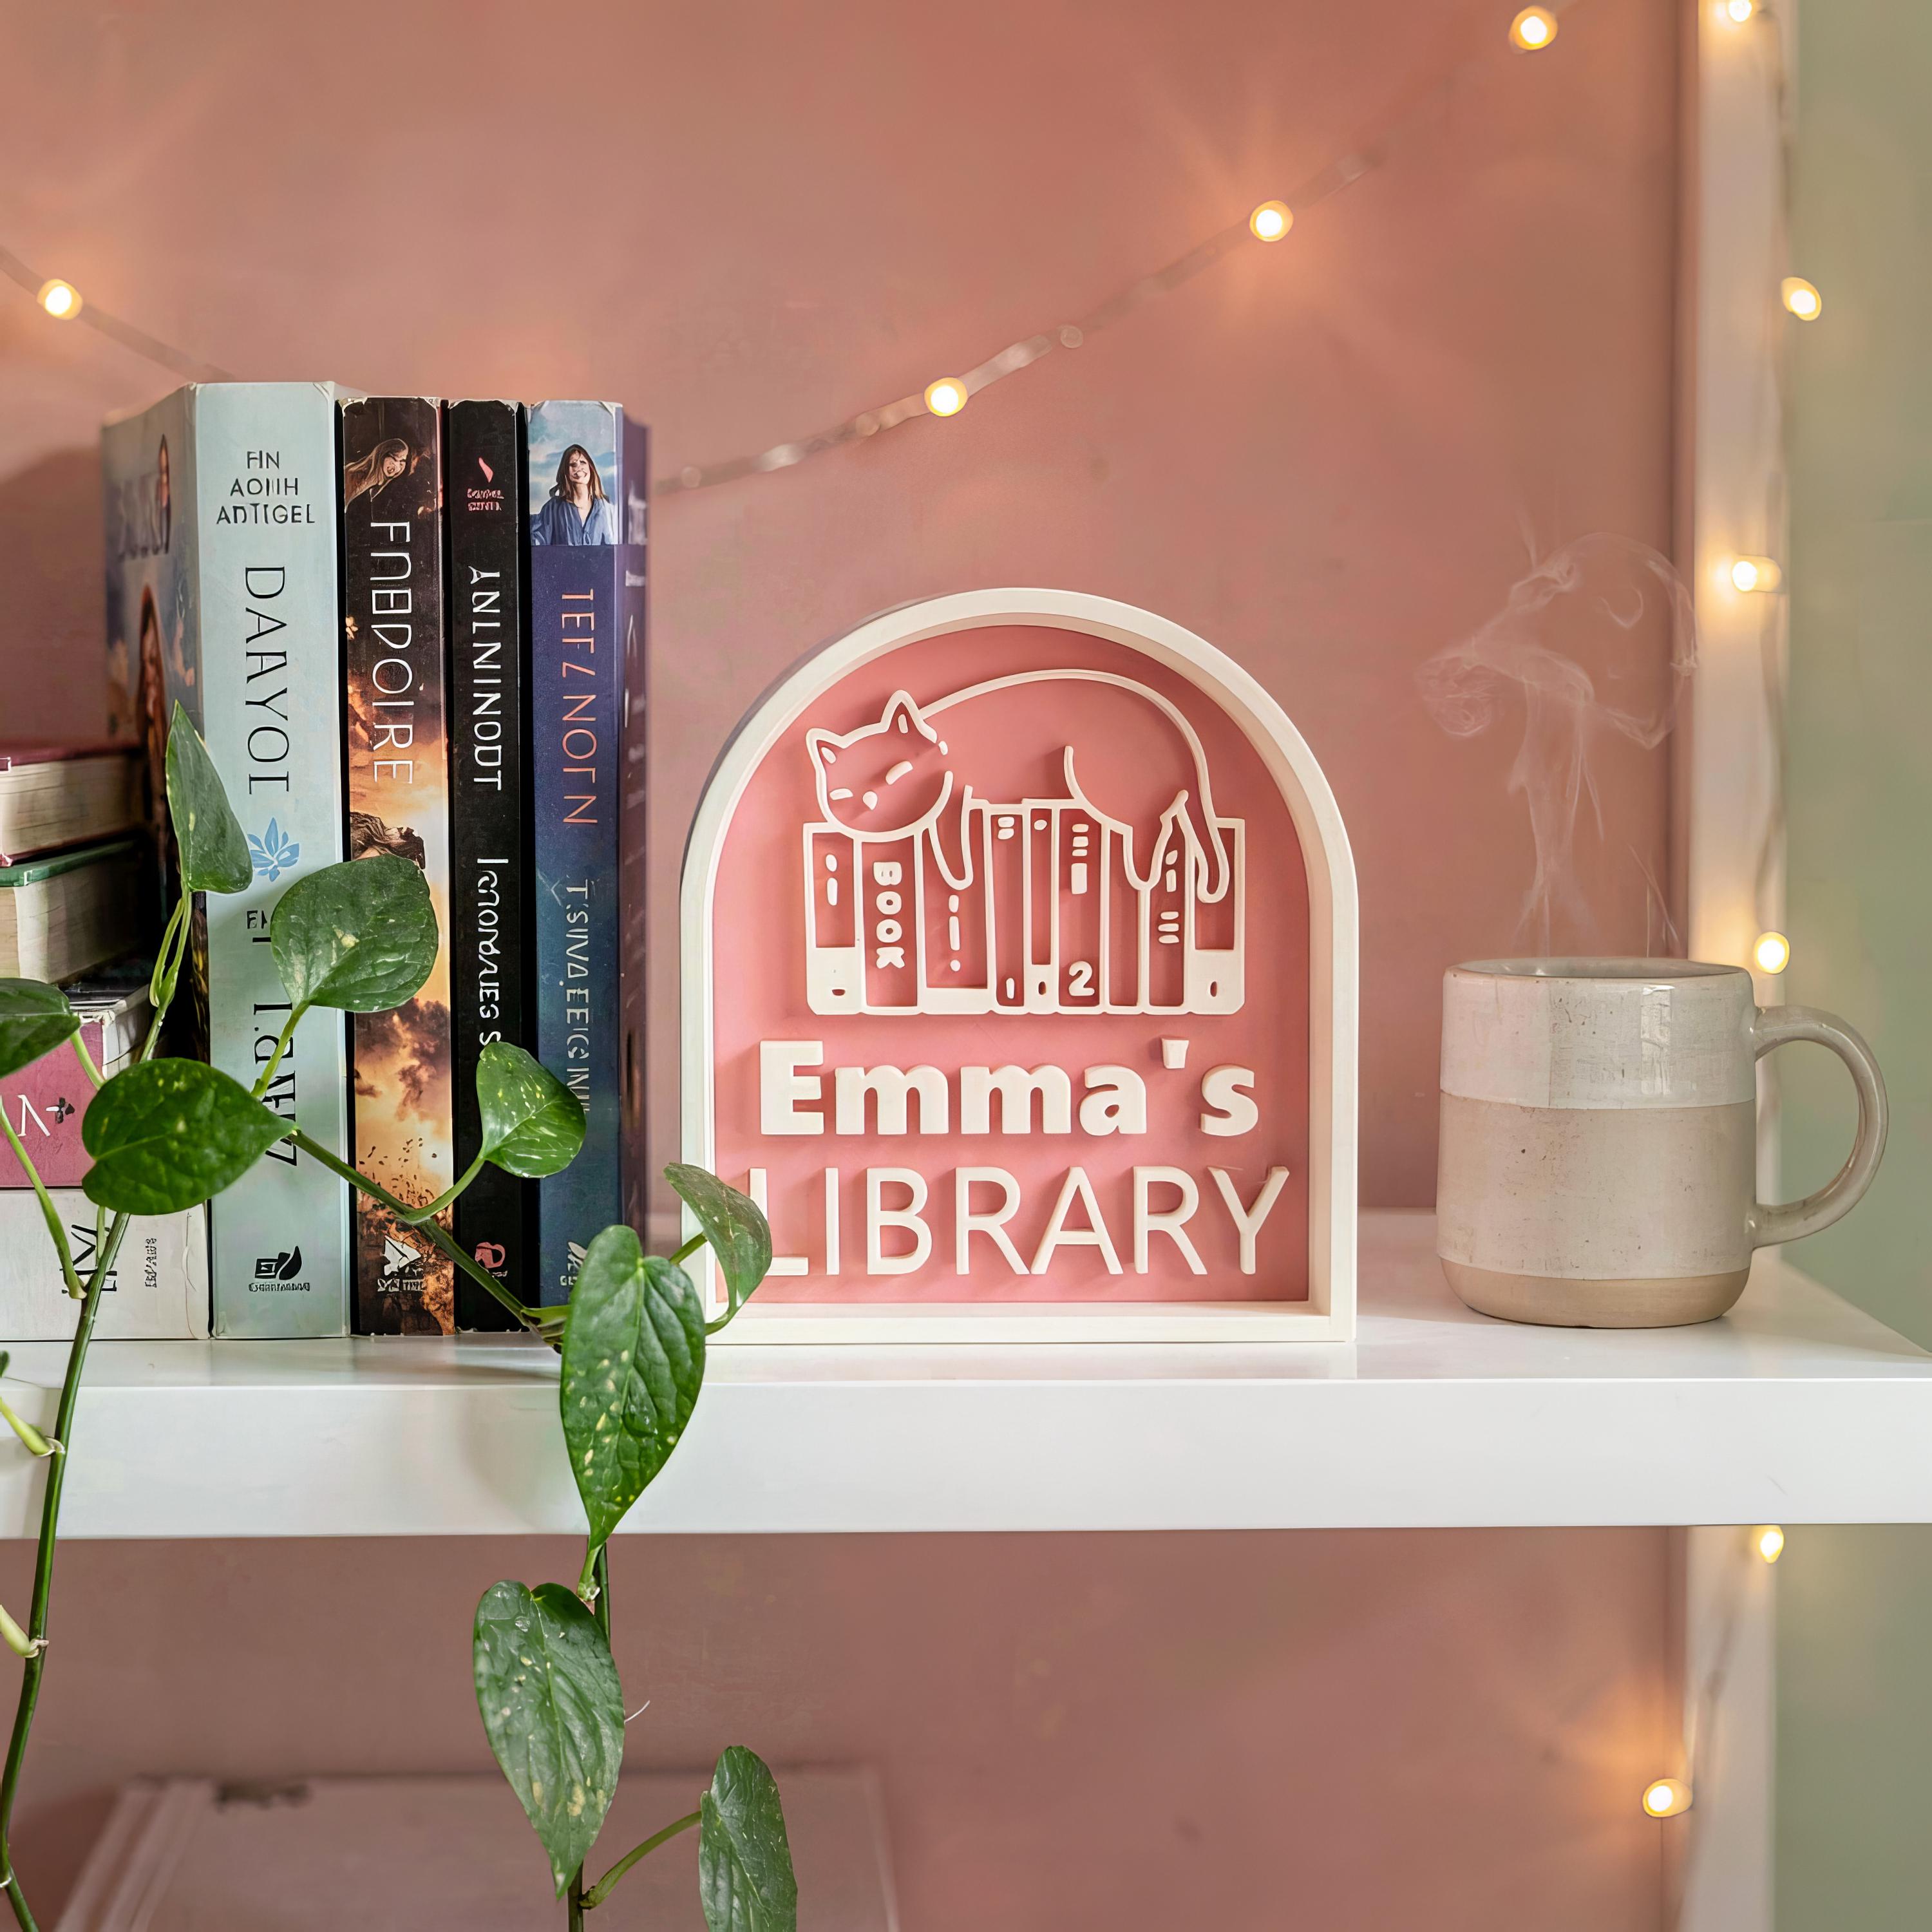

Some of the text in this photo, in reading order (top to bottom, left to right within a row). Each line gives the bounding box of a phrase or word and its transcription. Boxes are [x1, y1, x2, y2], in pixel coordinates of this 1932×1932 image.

[873, 861, 905, 969] BOOK
[1069, 961, 1094, 996] 2
[760, 1037, 1258, 1136] Emma's
[749, 1166, 1289, 1276] LIBRARY
